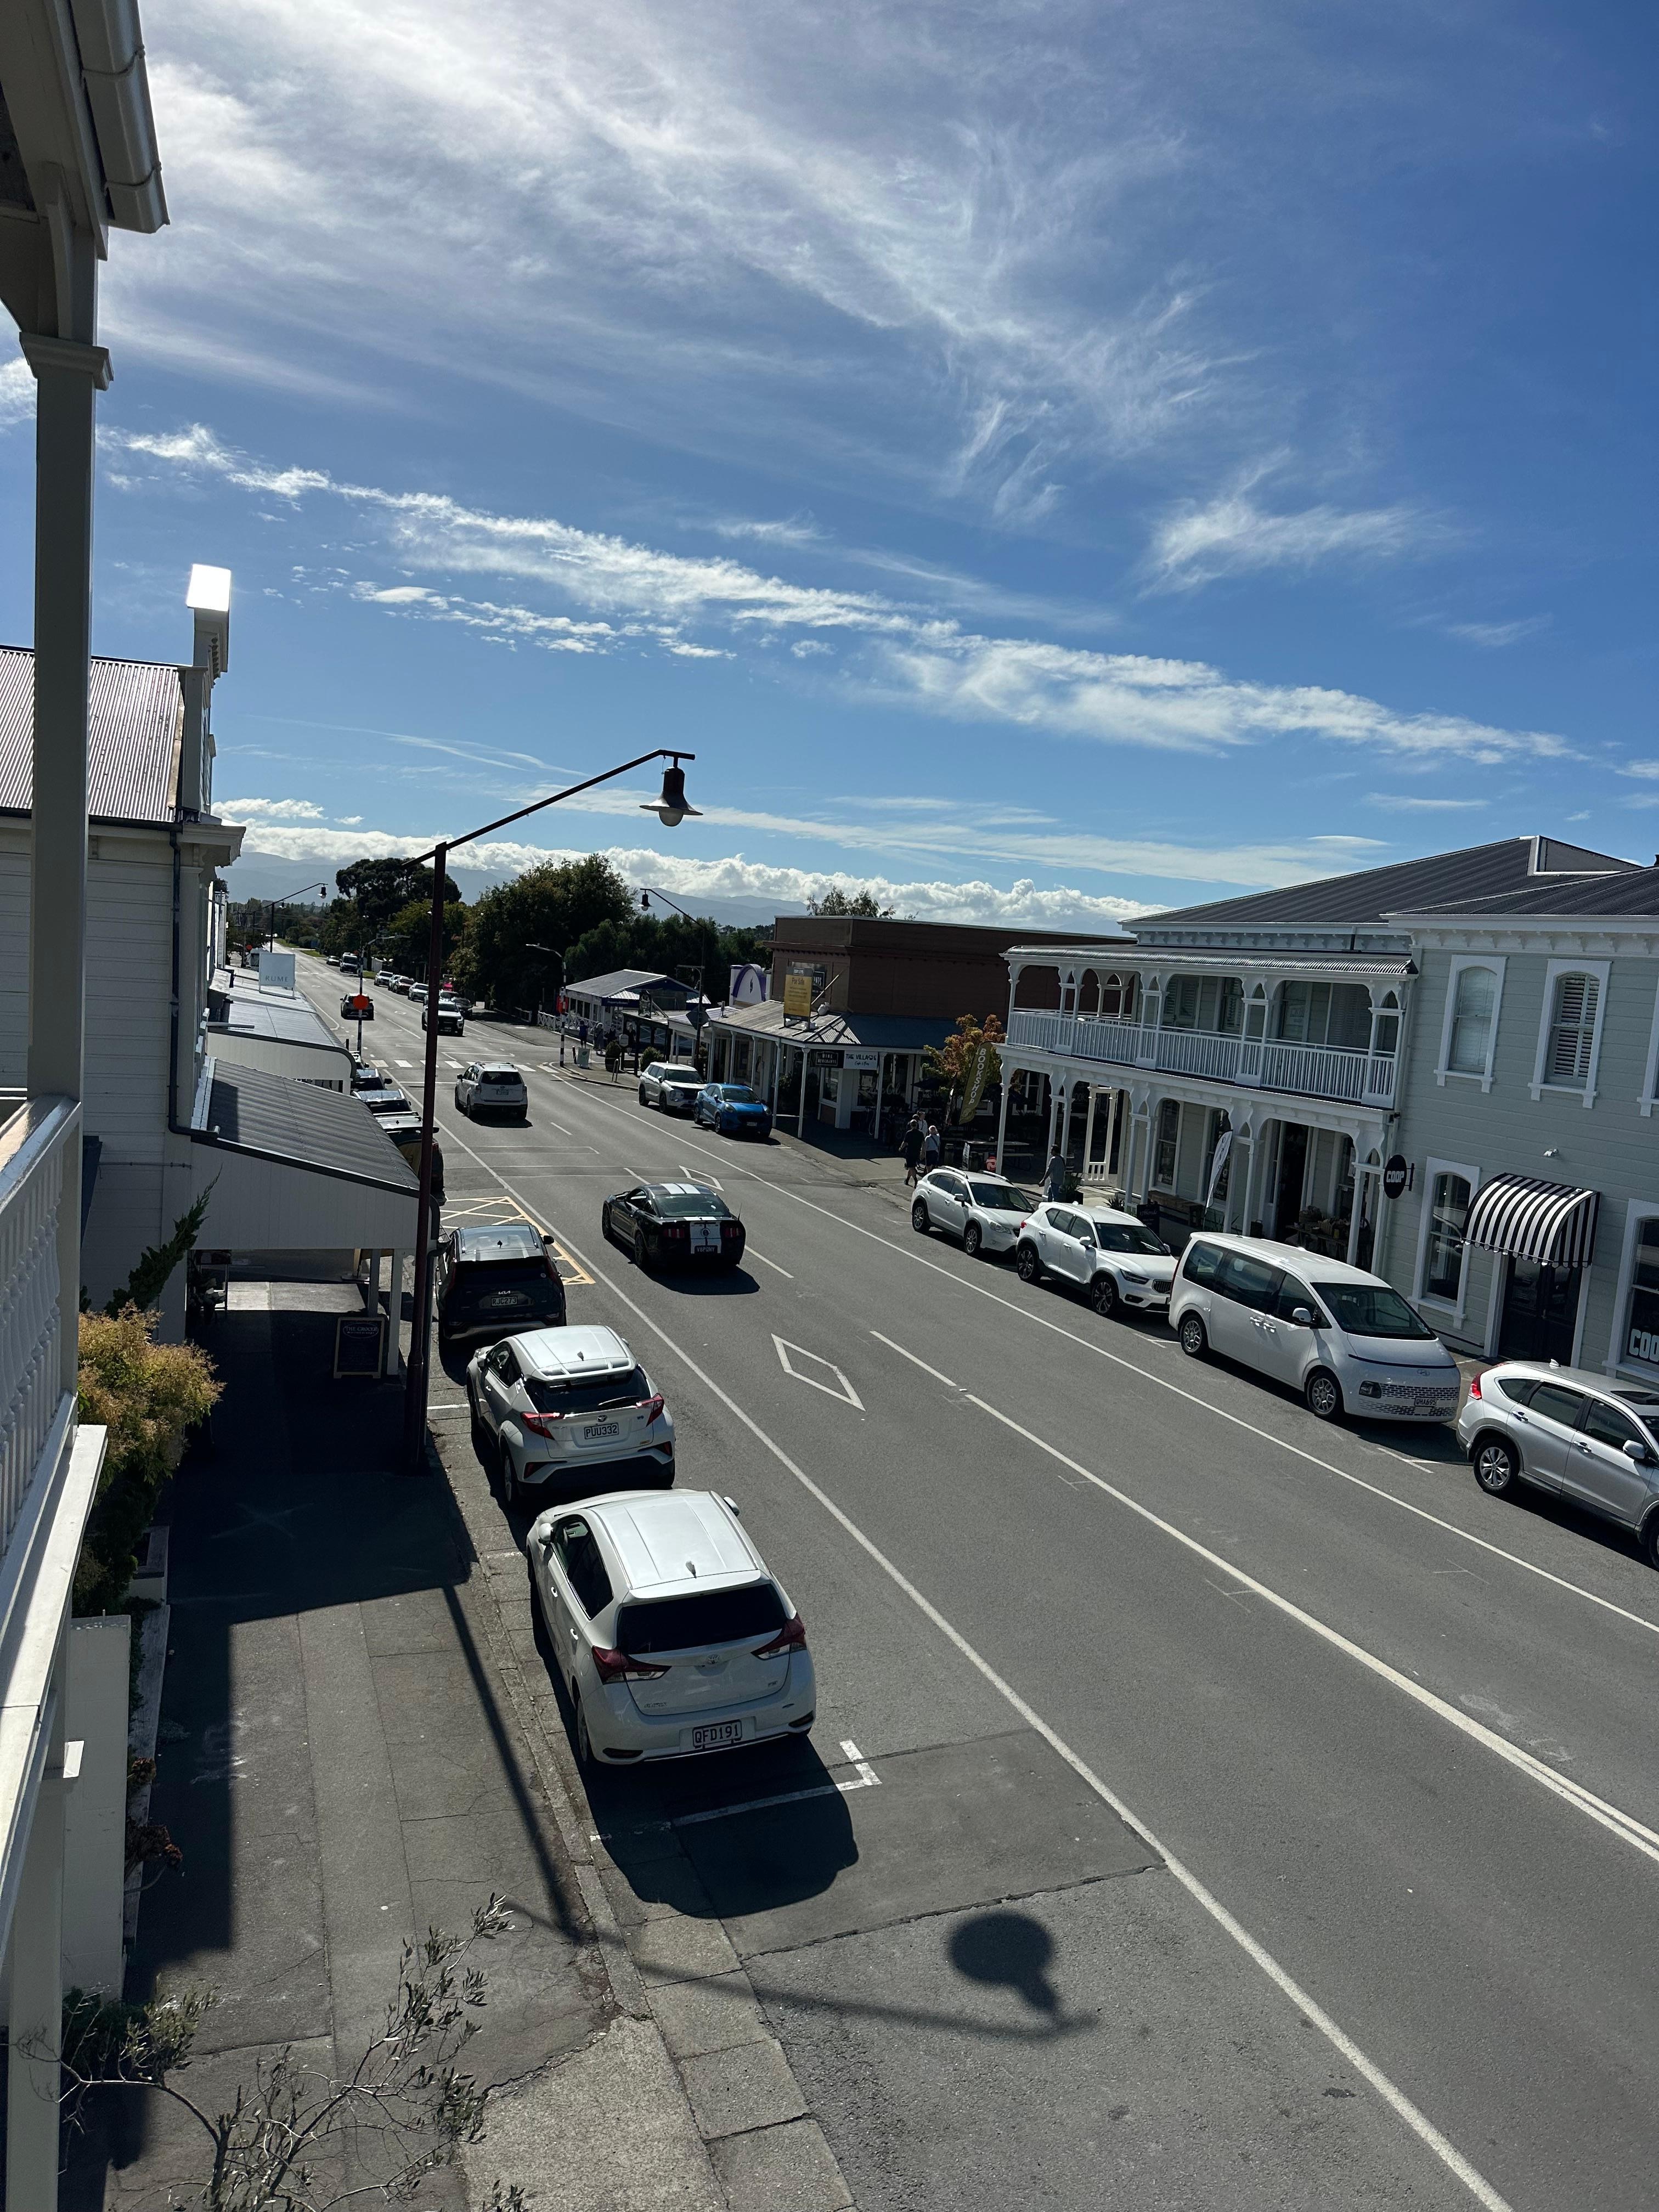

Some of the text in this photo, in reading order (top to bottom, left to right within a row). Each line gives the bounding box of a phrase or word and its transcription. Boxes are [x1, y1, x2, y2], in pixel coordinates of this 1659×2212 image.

[968, 1048, 986, 1105] BOOKSHOP
[1386, 1171, 1404, 1183] COOP
[492, 1297, 517, 1305] RJC273
[585, 1425, 618, 1438] PUU332
[694, 1724, 739, 1743] QFD191
